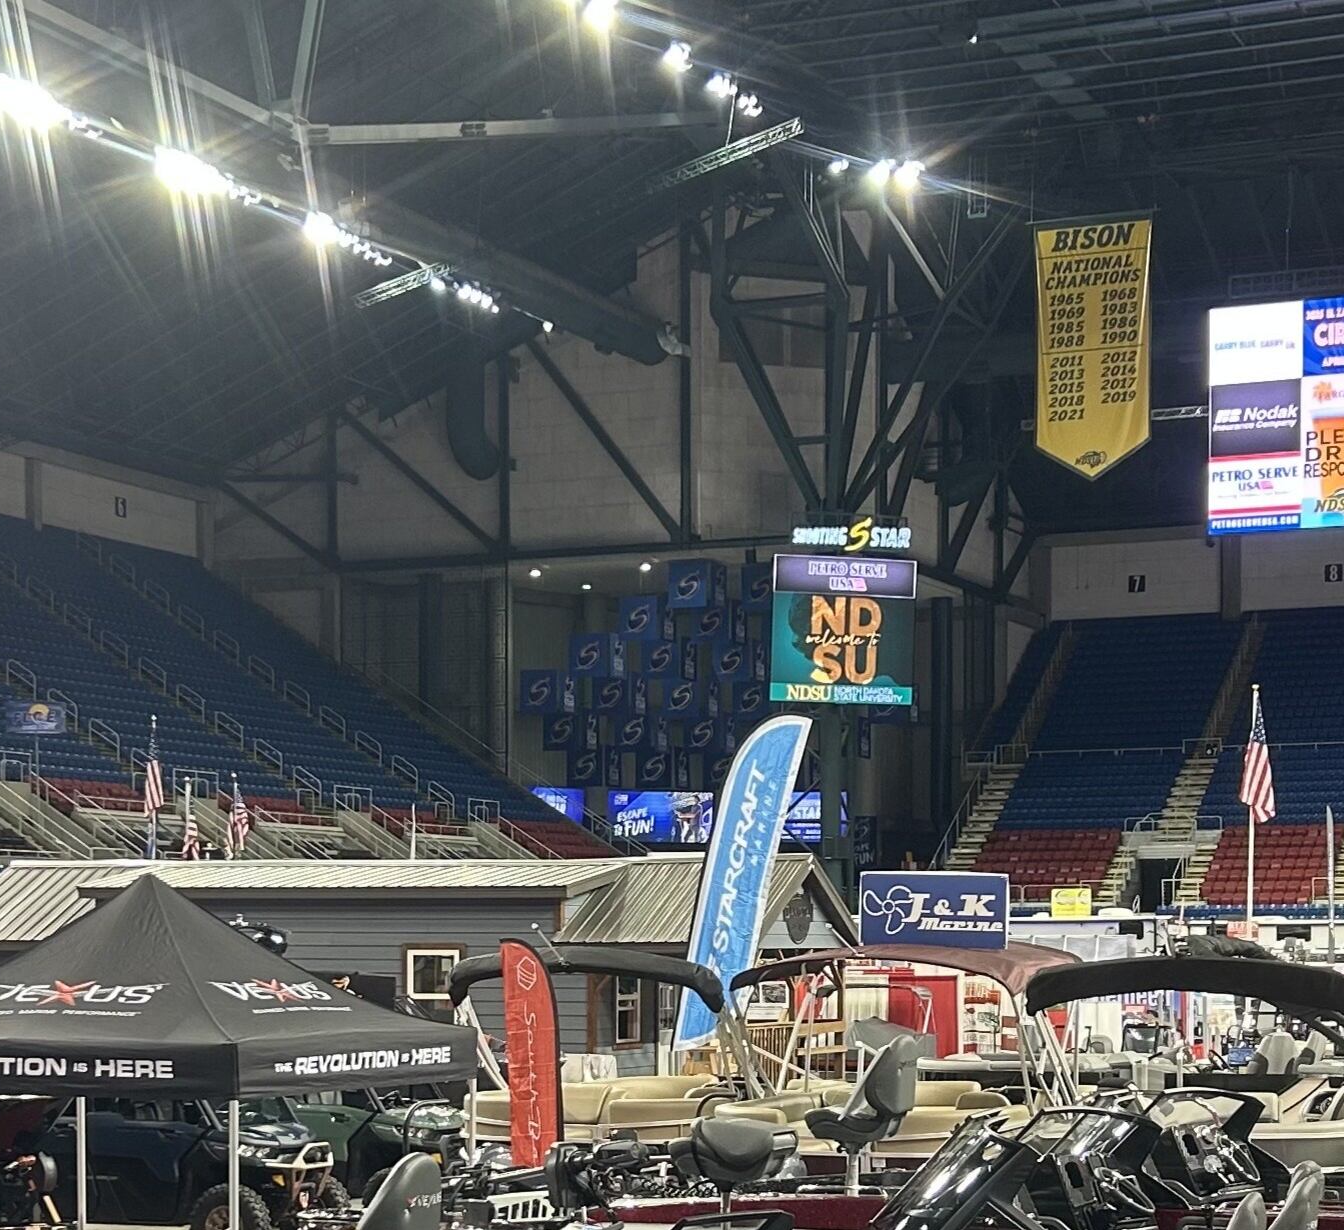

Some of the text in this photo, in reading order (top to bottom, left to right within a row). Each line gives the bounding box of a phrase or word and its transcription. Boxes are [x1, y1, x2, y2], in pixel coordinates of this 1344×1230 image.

[1051, 223, 1135, 252] BISON
[1051, 254, 1134, 276] NATIONAL
[1045, 269, 1141, 290] CHAMPIONS
[1049, 288, 1137, 307] 1965 1968
[1049, 302, 1137, 321] 1969 1983
[1049, 316, 1137, 335] 1985 1986
[1049, 330, 1137, 349] 1988 1990
[1049, 351, 1137, 368] 2011 2012
[1049, 365, 1137, 382] 2013 2014
[1049, 378, 1137, 395] 2015 2017
[1049, 391, 1137, 408] 2018 2019
[1048, 409, 1084, 422] 2021
[1244, 405, 1299, 422] Nodak
[1212, 466, 1299, 483] PETRO SERVE
[1238, 481, 1261, 492] USA
[869, 526, 912, 549] STAR
[829, 577, 854, 591] USA
[811, 595, 883, 637] ND
[806, 629, 865, 648] welcome
[810, 644, 878, 685] SU
[786, 684, 833, 702] NDSU
[859, 694, 904, 704] UNIVERSITY
[864, 686, 894, 697] DAKOTA
[617, 806, 648, 822] ESCAPE
[623, 818, 655, 839] FUN!
[712, 759, 767, 956] STARCRAFT
[901, 893, 996, 923] J & K
[917, 917, 1003, 932] Marine
[208, 978, 333, 1003] VEXUS
[73, 1061, 89, 1074] IS
[94, 1059, 175, 1079] HERE
[274, 1046, 452, 1076] THE REVOLUTION HERE
